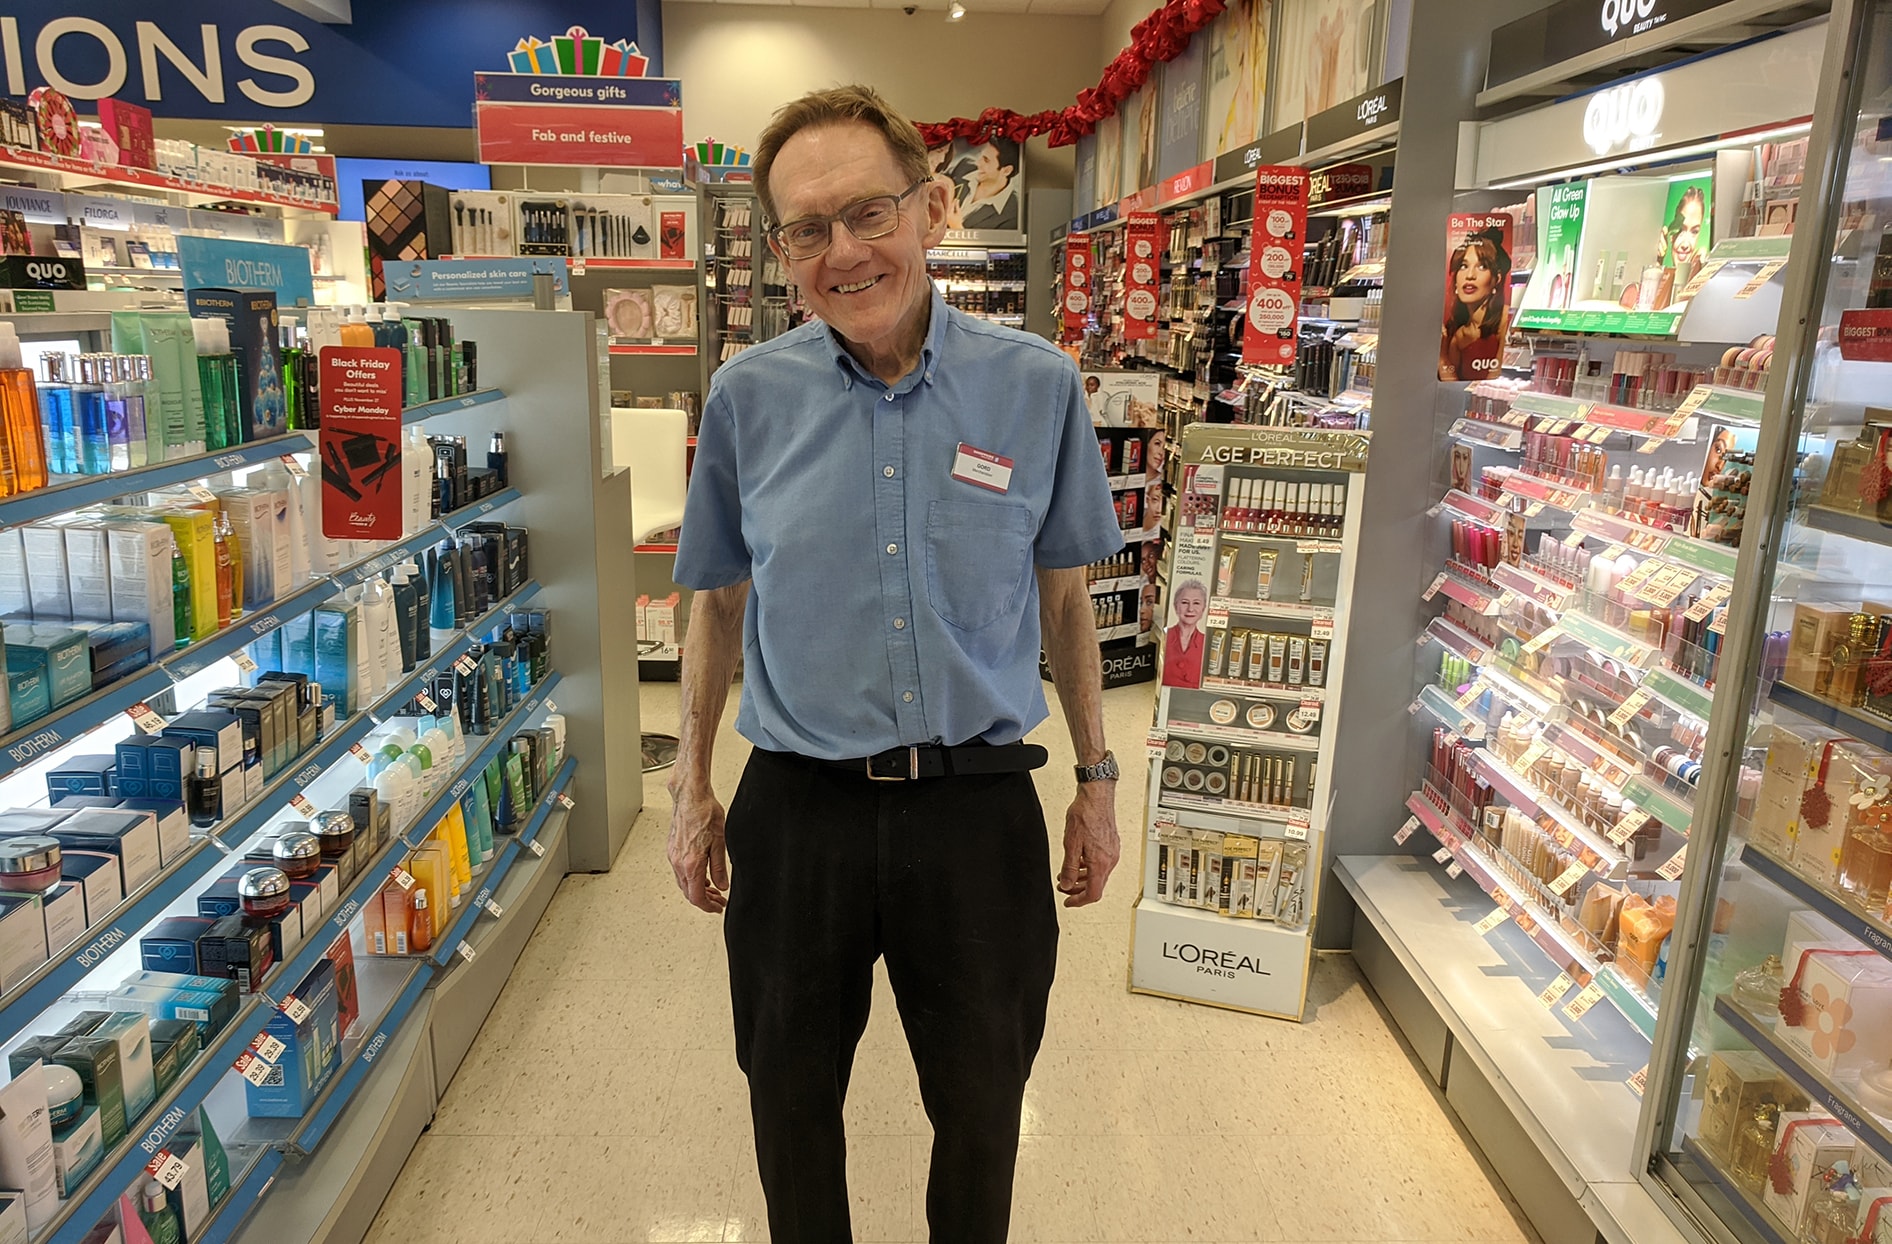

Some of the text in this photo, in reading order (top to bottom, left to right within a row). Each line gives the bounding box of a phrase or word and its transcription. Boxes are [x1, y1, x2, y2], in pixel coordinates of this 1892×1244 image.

[1601, 0, 1657, 38] QUO
[1633, 18, 1654, 35] BEAUTY
[530, 83, 627, 101] Gorgeous gifts
[1357, 95, 1388, 121] L'ORÉAL
[1365, 114, 1378, 126] PARIS
[1583, 77, 1665, 156] QUO
[531, 128, 632, 145] Fab and festive
[1174, 176, 1192, 194] REVLON
[1260, 175, 1305, 187] BIGGEST
[1258, 193, 1299, 201] REDEMPTION
[1259, 184, 1300, 195] BONUS
[1552, 187, 1584, 204] All Green
[5, 195, 52, 213] JOUVIANCE
[84, 206, 119, 221] FILORGA
[1129, 217, 1158, 225] BIGGEST
[1551, 204, 1580, 222] Glow Up
[1129, 224, 1156, 233] BONUS
[1451, 217, 1507, 228] Be The Star
[927, 250, 969, 258] MARCELLE
[26, 262, 67, 280] QUO
[225, 258, 284, 287] BIOTHERM
[432, 269, 527, 281] Personalized skin care
[1256, 298, 1283, 310] $400
[1844, 326, 1877, 337] BIGGEST
[331, 357, 390, 370] Black Friday
[1471, 358, 1500, 372] QUO
[346, 369, 377, 380] Offers
[343, 381, 364, 389] Beautiful
[333, 404, 390, 416] Cyber Monday
[1251, 431, 1297, 443] L'ORÉAL
[214, 453, 247, 469] BIOTHERM
[1200, 445, 1349, 470] AGE PERFECT
[1692, 605, 1708, 614] 5,000
[252, 614, 280, 636] BIOTHERM
[1209, 618, 1226, 627] 12.49
[1312, 629, 1331, 638] 12.49
[1102, 654, 1151, 676] ORÉAL
[1110, 670, 1133, 680] PARIS
[1300, 710, 1317, 719] 12.49
[8, 728, 62, 763] BIOTHERM
[1149, 750, 1162, 758] 7.49
[294, 762, 322, 787] BIOTHERM
[1286, 828, 1304, 838] 10.99
[1615, 827, 1628, 838] 5,000
[1665, 862, 1679, 874] 5,000
[333, 899, 360, 927] BIOTHERM
[76, 927, 126, 969] BIOTHERM
[1162, 942, 1271, 977] L'ORÉAL
[1196, 965, 1236, 980] PARIS
[280, 994, 294, 1010] Sale
[251, 1032, 267, 1049] Sale
[362, 1031, 388, 1063] BIOTHERM
[235, 1053, 253, 1070] Sale
[1827, 1094, 1862, 1130] Fragrance
[140, 1105, 187, 1155] BIOTHERM
[147, 1150, 168, 1173] Sale
[163, 1161, 184, 1184] 43.79
